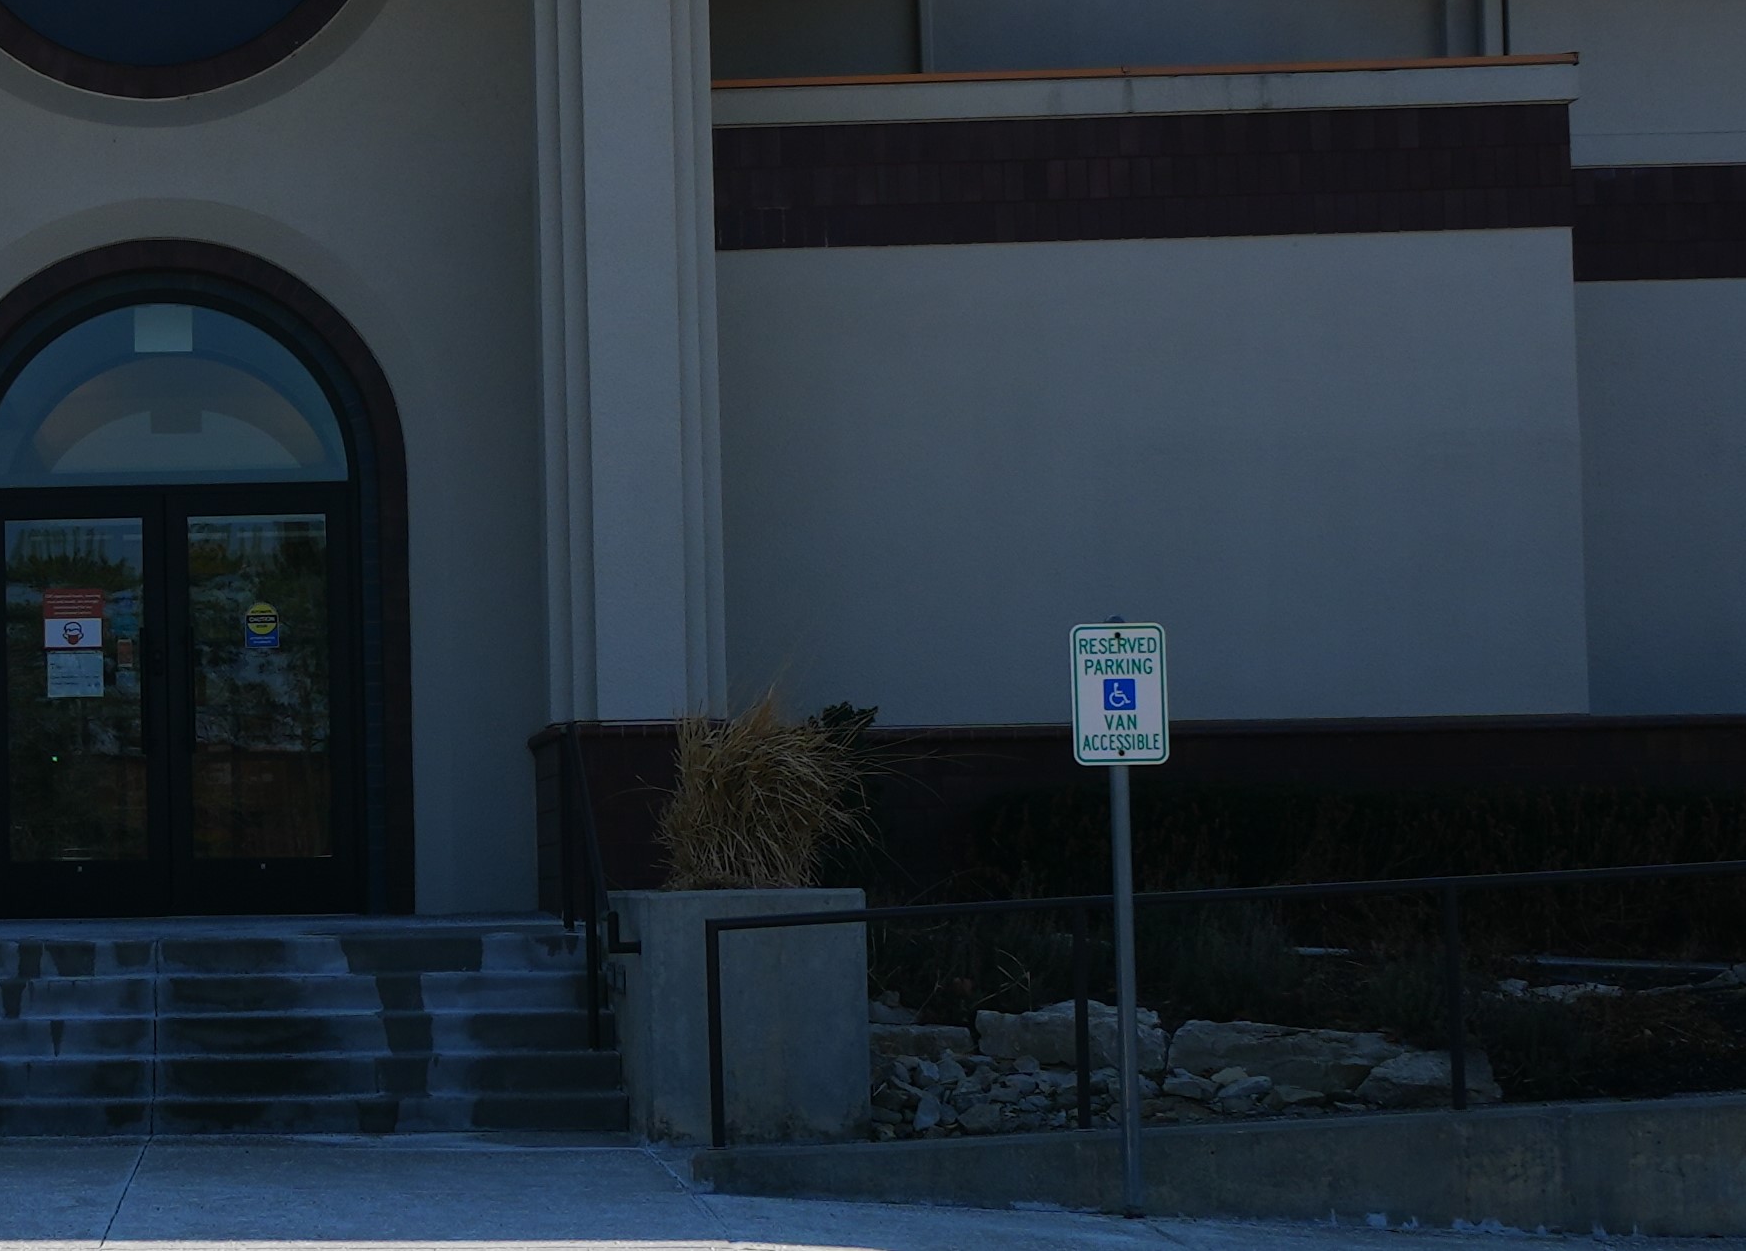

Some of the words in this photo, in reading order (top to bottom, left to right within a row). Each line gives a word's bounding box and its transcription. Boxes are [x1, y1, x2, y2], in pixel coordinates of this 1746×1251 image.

[1078, 637, 1157, 655] RESERVED
[1084, 658, 1154, 676] PARKING
[1103, 714, 1137, 731] VAN
[1082, 733, 1161, 751] ACCESSIBLE
